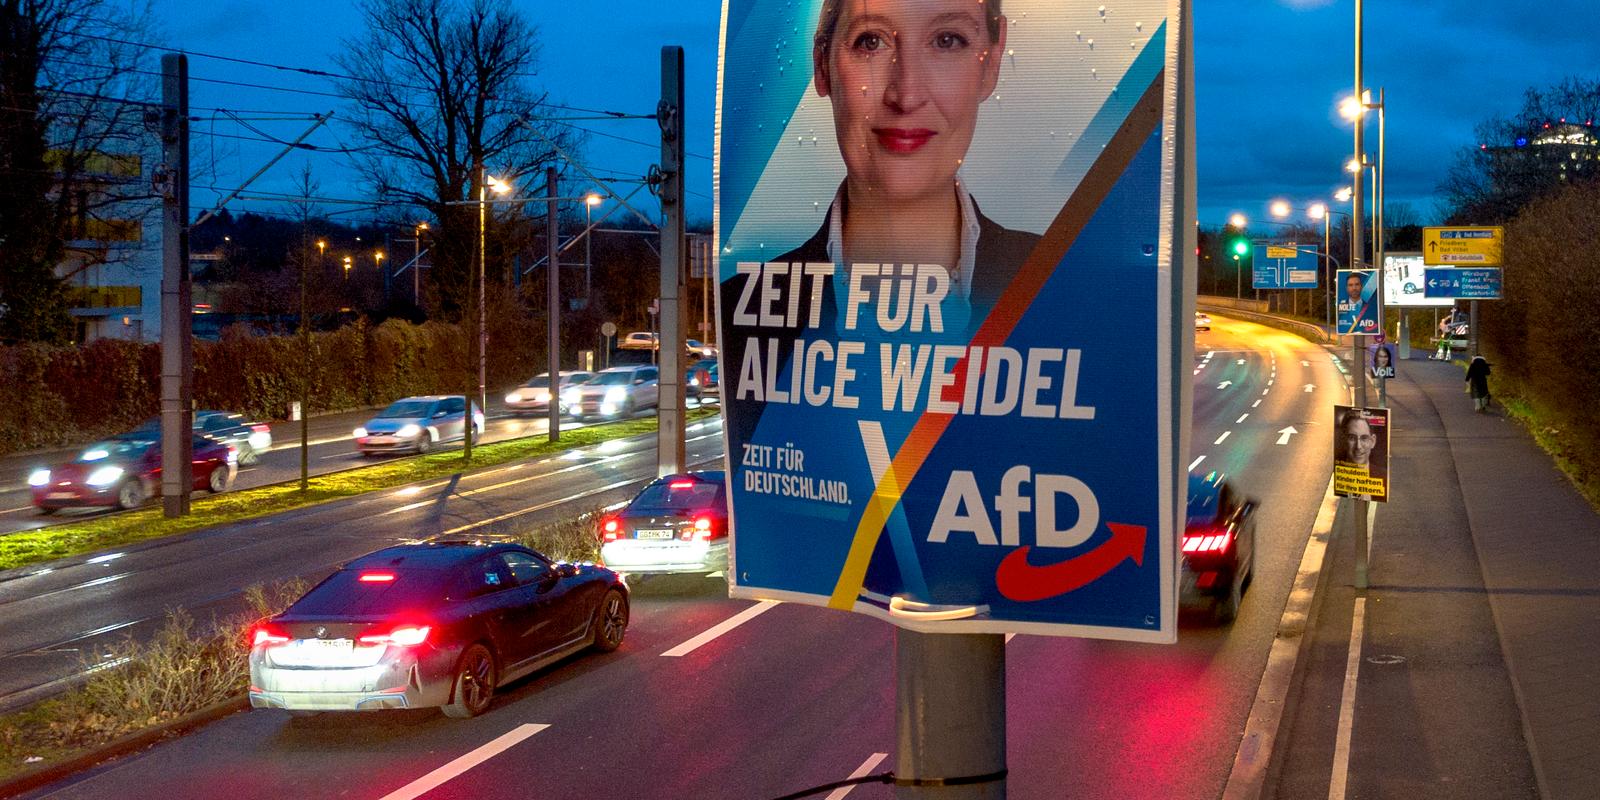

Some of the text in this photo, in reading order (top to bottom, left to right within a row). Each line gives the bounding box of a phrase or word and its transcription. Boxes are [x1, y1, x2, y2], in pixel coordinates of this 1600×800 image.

[733, 262, 949, 333] ZEIT FÜR
[1339, 304, 1356, 312] NOLTE
[1360, 319, 1374, 327] AfD
[1372, 366, 1393, 377] Volt
[736, 337, 1096, 420] ALICE WEIDEL
[742, 443, 804, 471] ZEIT FÜR
[1337, 468, 1368, 476] Schulden:
[745, 470, 852, 505] DEUTSCHLAND.
[1356, 478, 1382, 486] haften
[1359, 486, 1384, 494] Eltern.
[927, 465, 1100, 549] AfD
